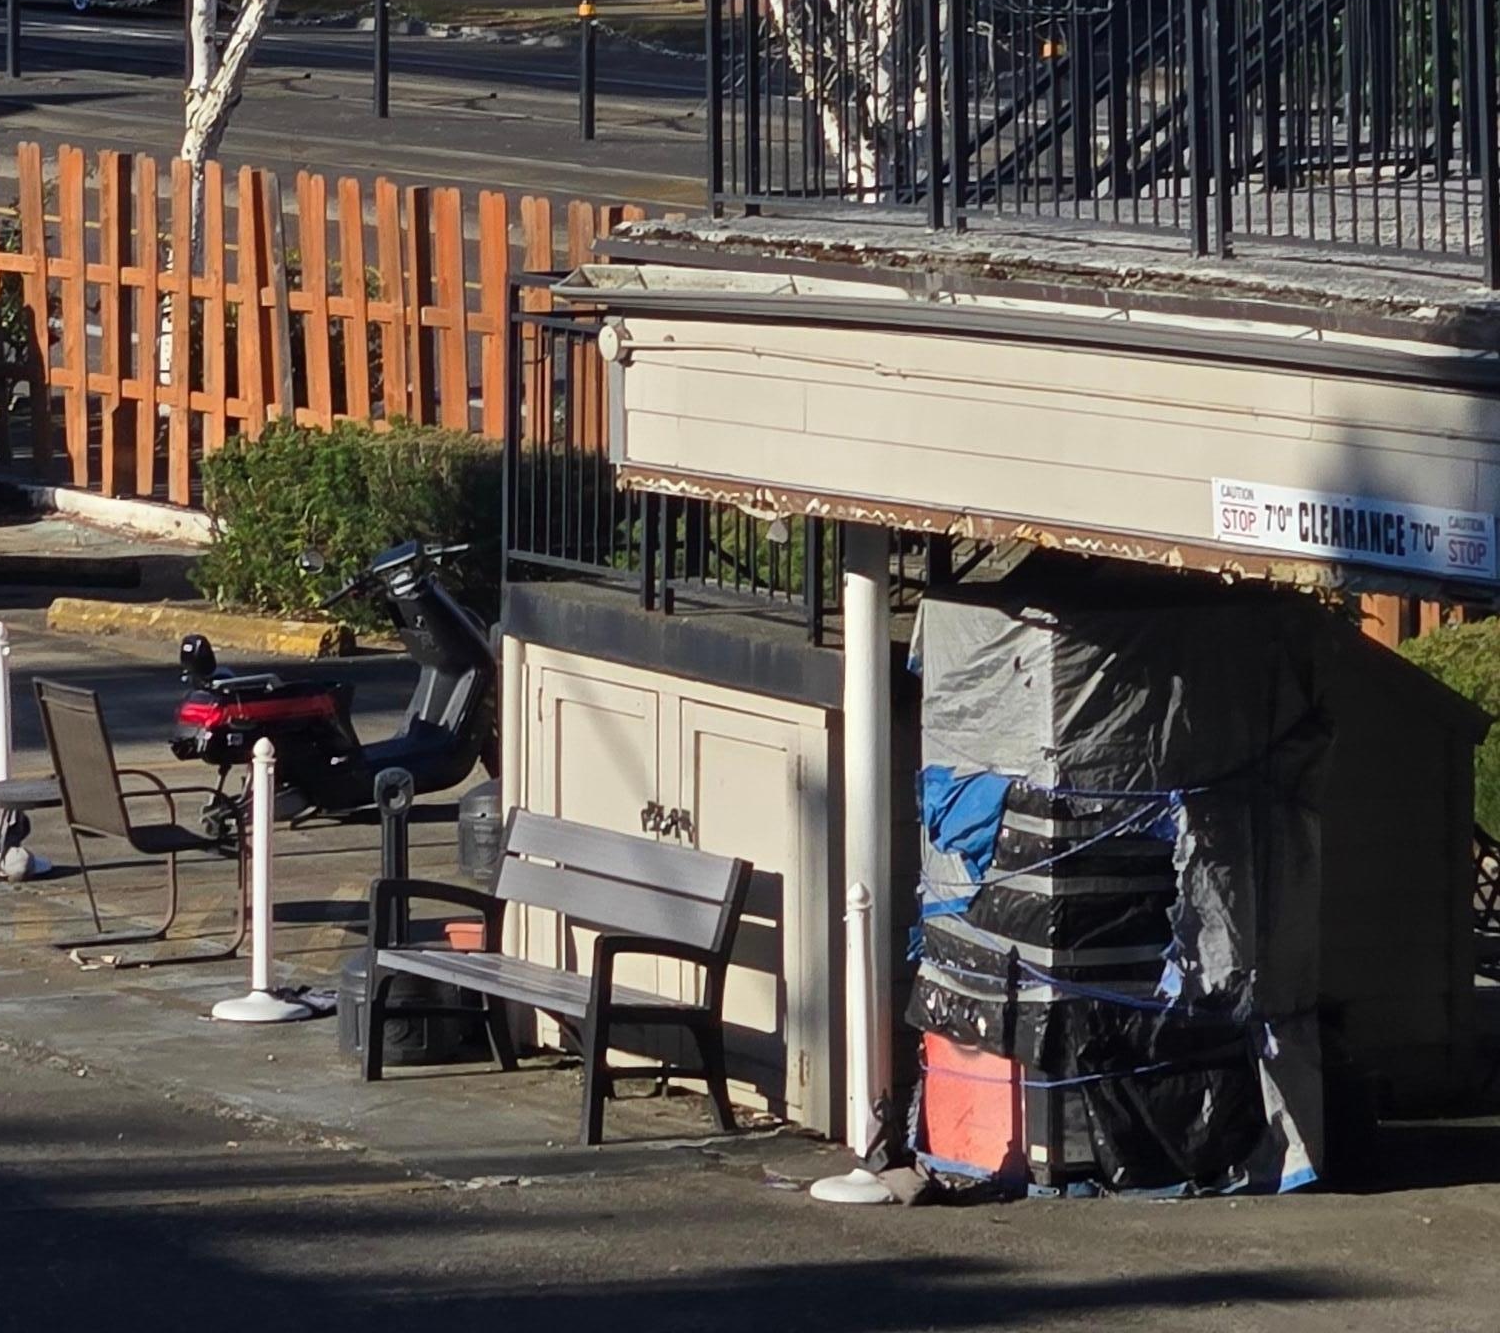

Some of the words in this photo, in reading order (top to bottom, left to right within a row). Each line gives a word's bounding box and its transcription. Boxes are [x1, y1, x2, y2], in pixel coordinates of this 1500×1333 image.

[1220, 482, 1255, 501] CAUTION
[1222, 509, 1257, 532] STOP
[1299, 501, 1406, 557] CLEARANCE
[1448, 515, 1486, 534] CAUTION
[1448, 540, 1487, 566] STOP
